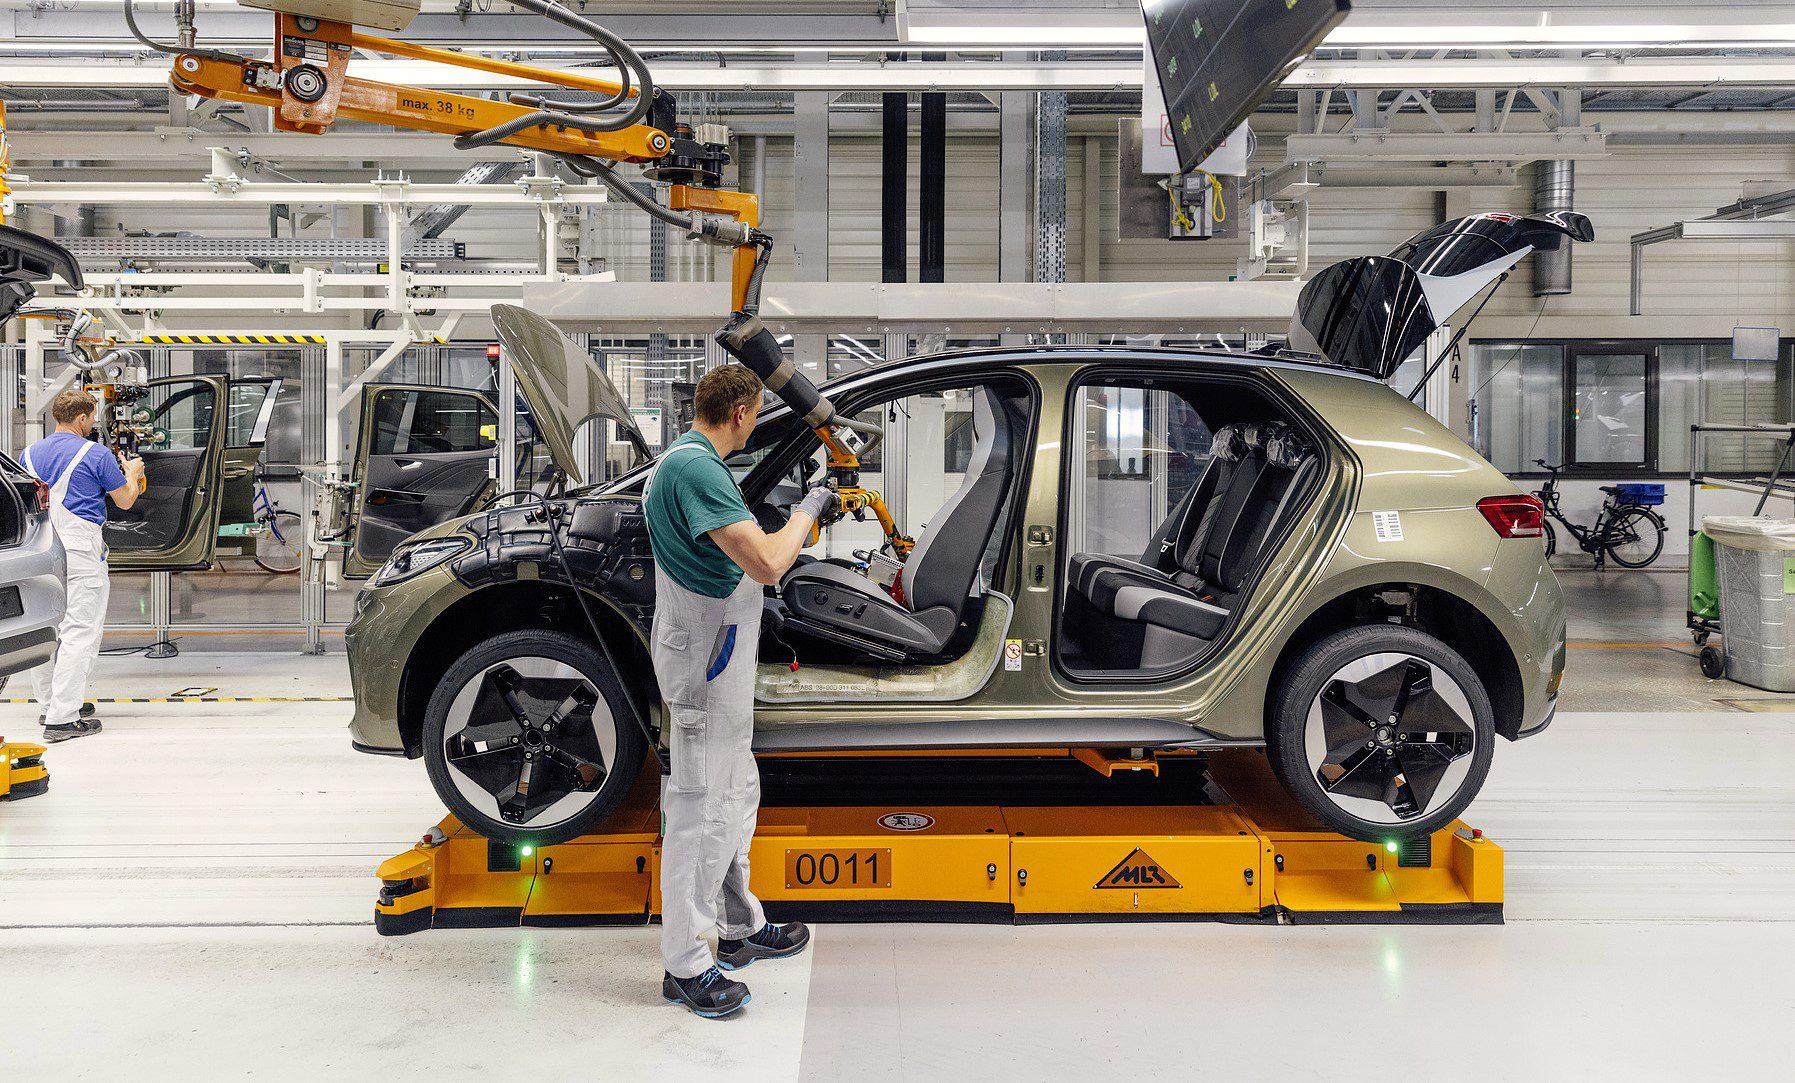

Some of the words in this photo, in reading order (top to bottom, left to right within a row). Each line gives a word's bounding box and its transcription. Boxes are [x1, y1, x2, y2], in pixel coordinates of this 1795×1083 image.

[402, 98, 433, 111] max.
[436, 101, 453, 114] 38
[457, 103, 475, 120] kg
[1452, 343, 1461, 361] A
[1452, 365, 1460, 383] 4
[796, 852, 877, 885] 0011
[1111, 865, 1166, 885] MLR
